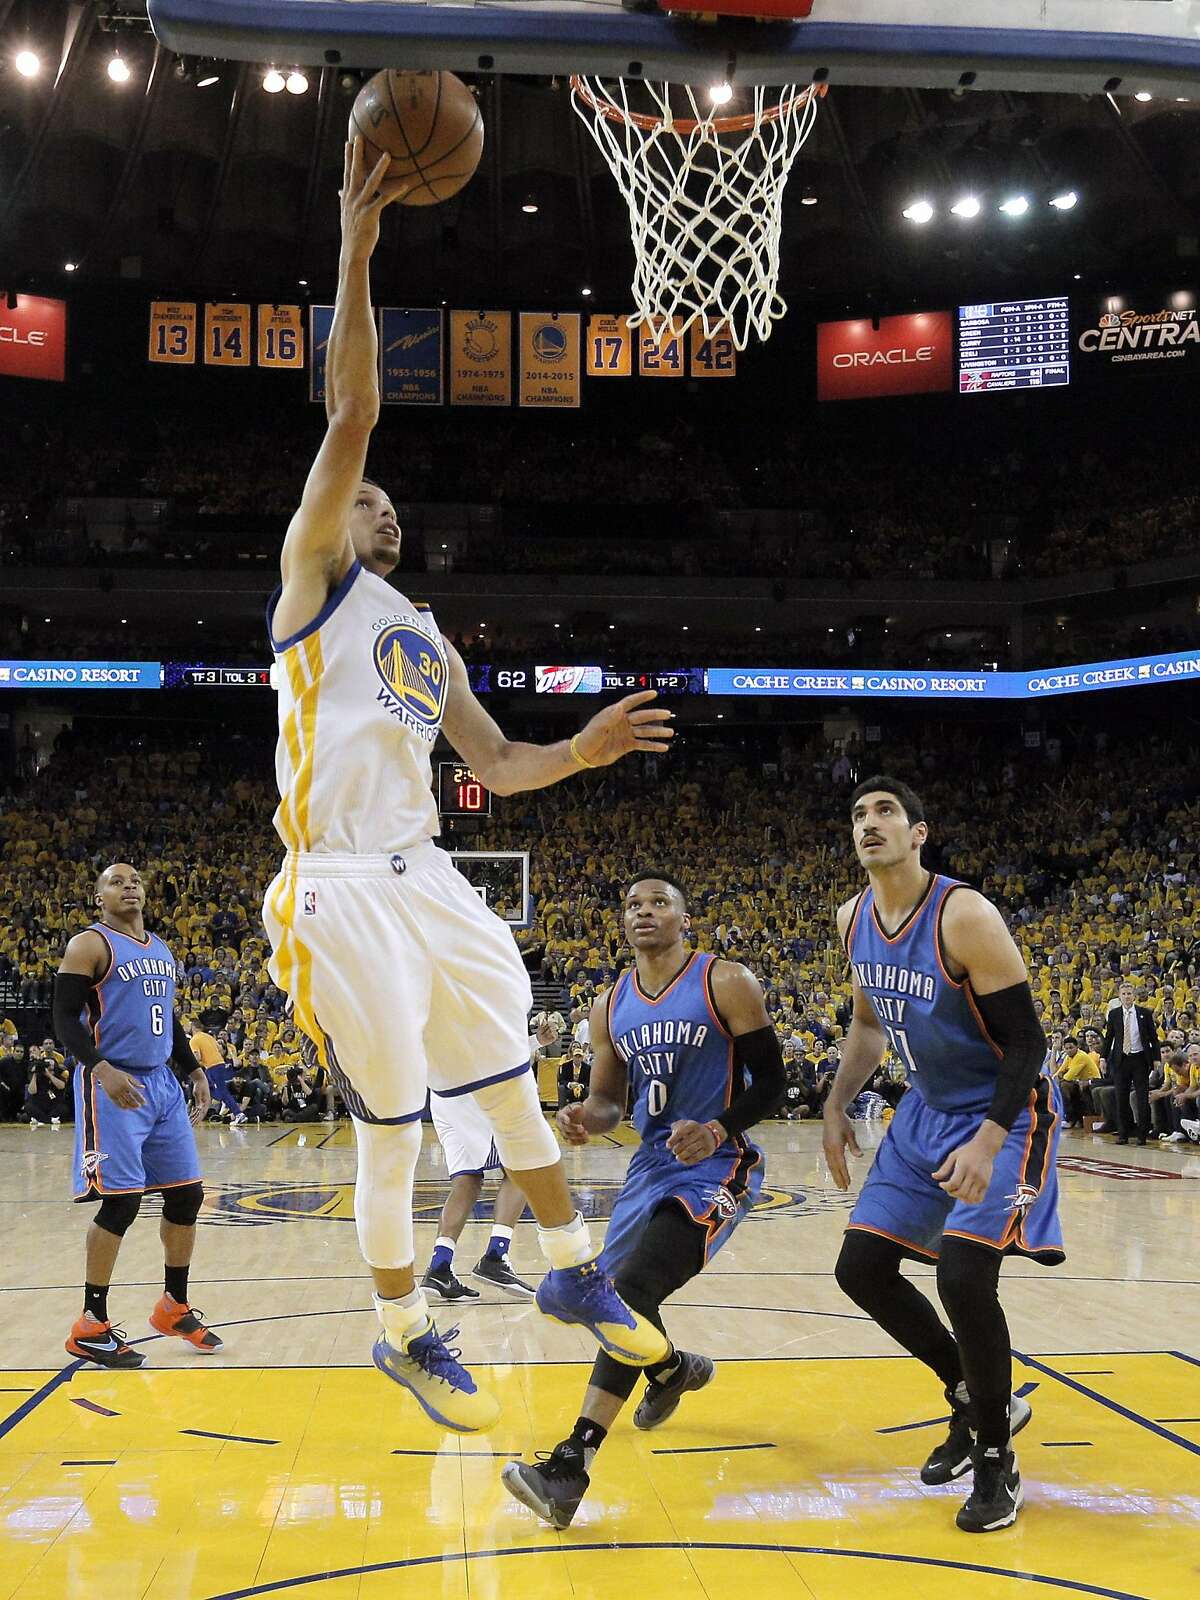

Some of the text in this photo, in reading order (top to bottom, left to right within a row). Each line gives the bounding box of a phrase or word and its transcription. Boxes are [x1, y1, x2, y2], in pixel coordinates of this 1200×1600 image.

[156, 324, 189, 356] 13
[212, 326, 243, 358] 14
[265, 328, 297, 360] 16
[1078, 320, 1200, 353] CENTRA
[593, 337, 623, 369] 17
[643, 338, 680, 369] 24
[695, 338, 732, 370] 42
[832, 346, 933, 368] ORACLE
[1111, 349, 1186, 363] CSNBAYAREA.COM
[456, 370, 505, 379] 1974-1975
[525, 371, 575, 381] 2014-2015
[987, 380, 1016, 388] CAVALIERS
[386, 391, 437, 400] CHAMPIONS
[456, 393, 505, 401] CHAMPIONS
[525, 395, 575, 403] CHAMPIONS
[541, 386, 558, 394] NBA
[371, 614, 419, 632] GOLDEN
[13, 667, 140, 682] CASINO RESORT
[191, 672, 205, 682] TF
[206, 671, 216, 682] 3
[225, 672, 244, 683] TOL
[247, 672, 257, 683] 3
[419, 651, 441, 685] 30
[1028, 659, 1200, 692] CACHE CREEK CASIN
[497, 671, 526, 688] 62
[605, 676, 624, 687] TOL
[625, 676, 636, 687] 2
[656, 676, 669, 687] TF
[669, 676, 679, 687] 2
[733, 676, 987, 692] CACHE CREEK CASINO RESORT
[458, 784, 481, 809] 10
[143, 979, 167, 997] CITY
[872, 995, 905, 1023] CITY
[151, 1003, 164, 1036] 6
[637, 1052, 674, 1075] CITY
[647, 1079, 668, 1117] 0
